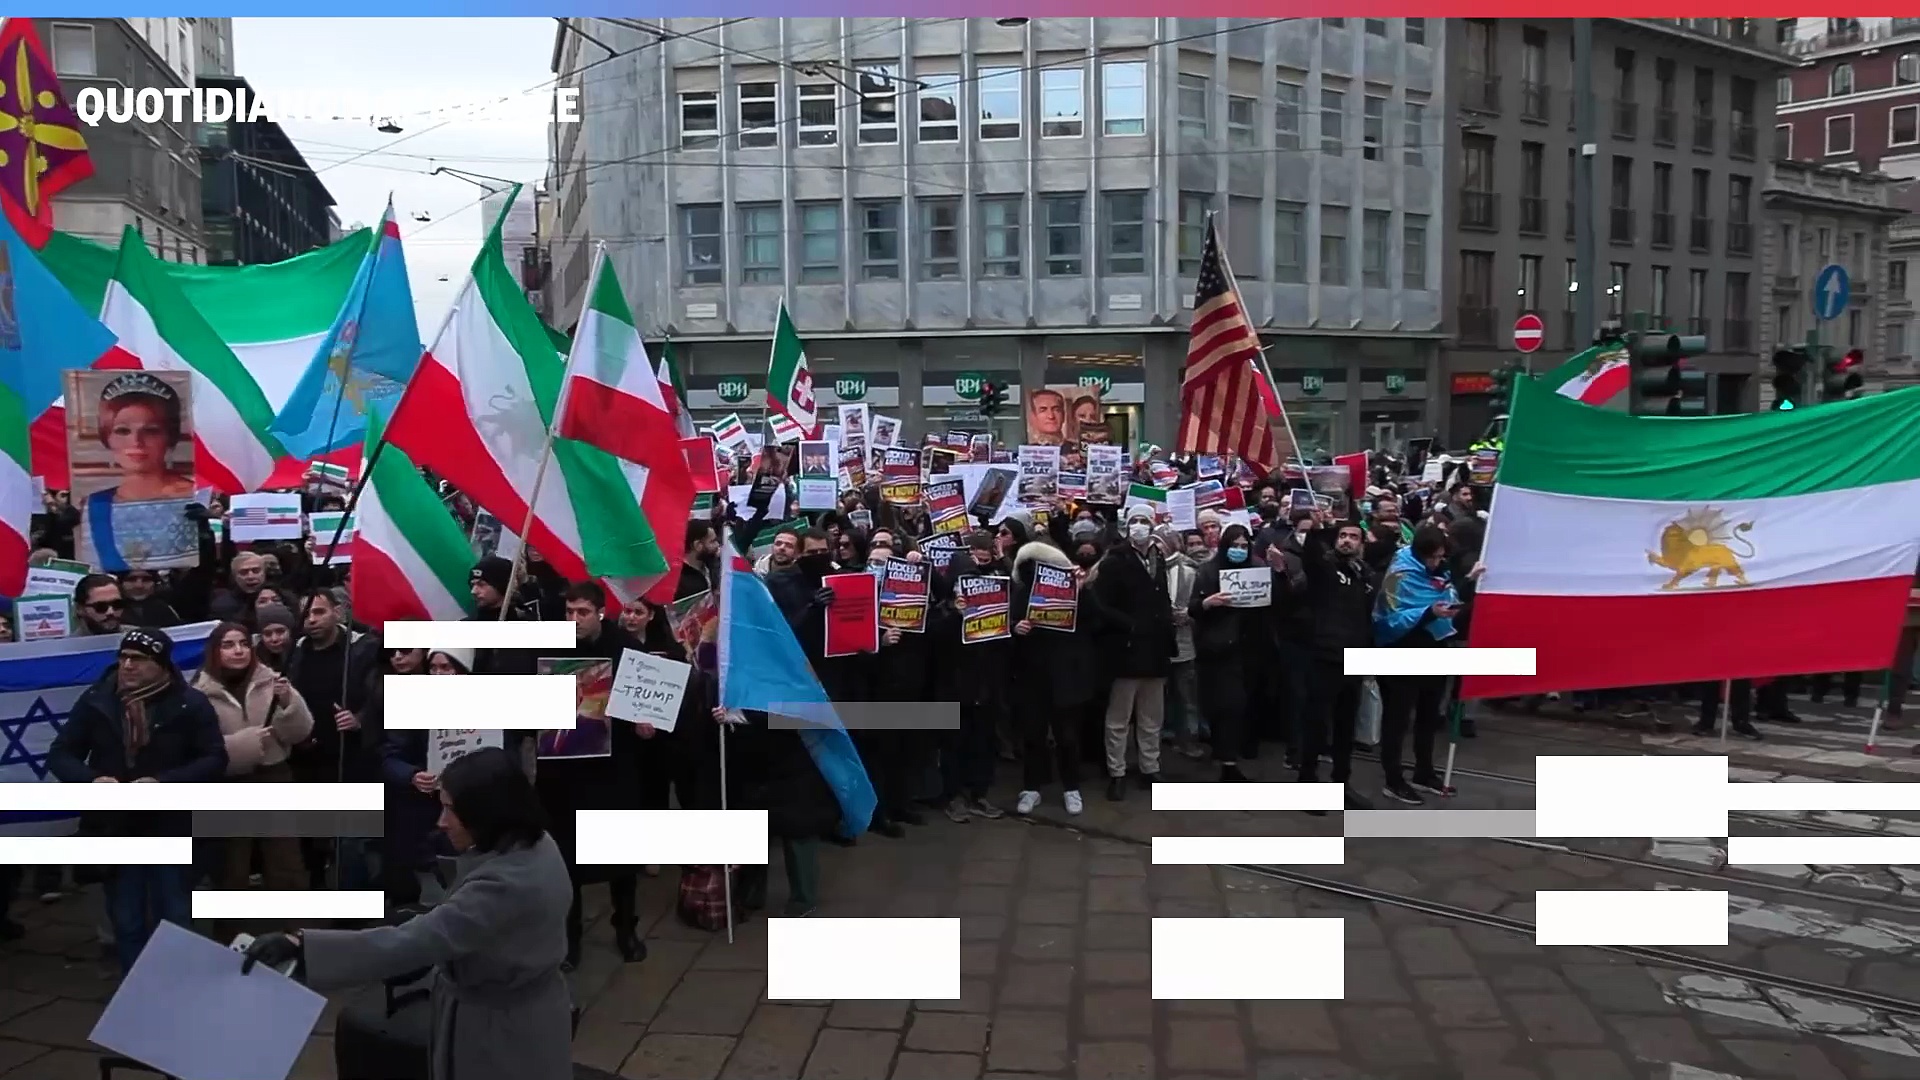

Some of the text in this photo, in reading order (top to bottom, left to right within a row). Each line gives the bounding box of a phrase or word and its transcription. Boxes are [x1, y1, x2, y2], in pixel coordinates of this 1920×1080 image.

[718, 381, 748, 398] BPM
[835, 380, 866, 396] BPM
[1023, 467, 1050, 475] DELAY
[887, 560, 917, 574] LOCKED
[1038, 565, 1066, 579] LOCKED
[889, 571, 922, 582] LOADED
[962, 578, 996, 588] LOCKED
[1040, 576, 1071, 589] LOADED
[967, 584, 1001, 597] LOADED
[881, 606, 896, 618] ACT
[896, 606, 923, 620] NOW!
[624, 684, 674, 706] TRUMP
